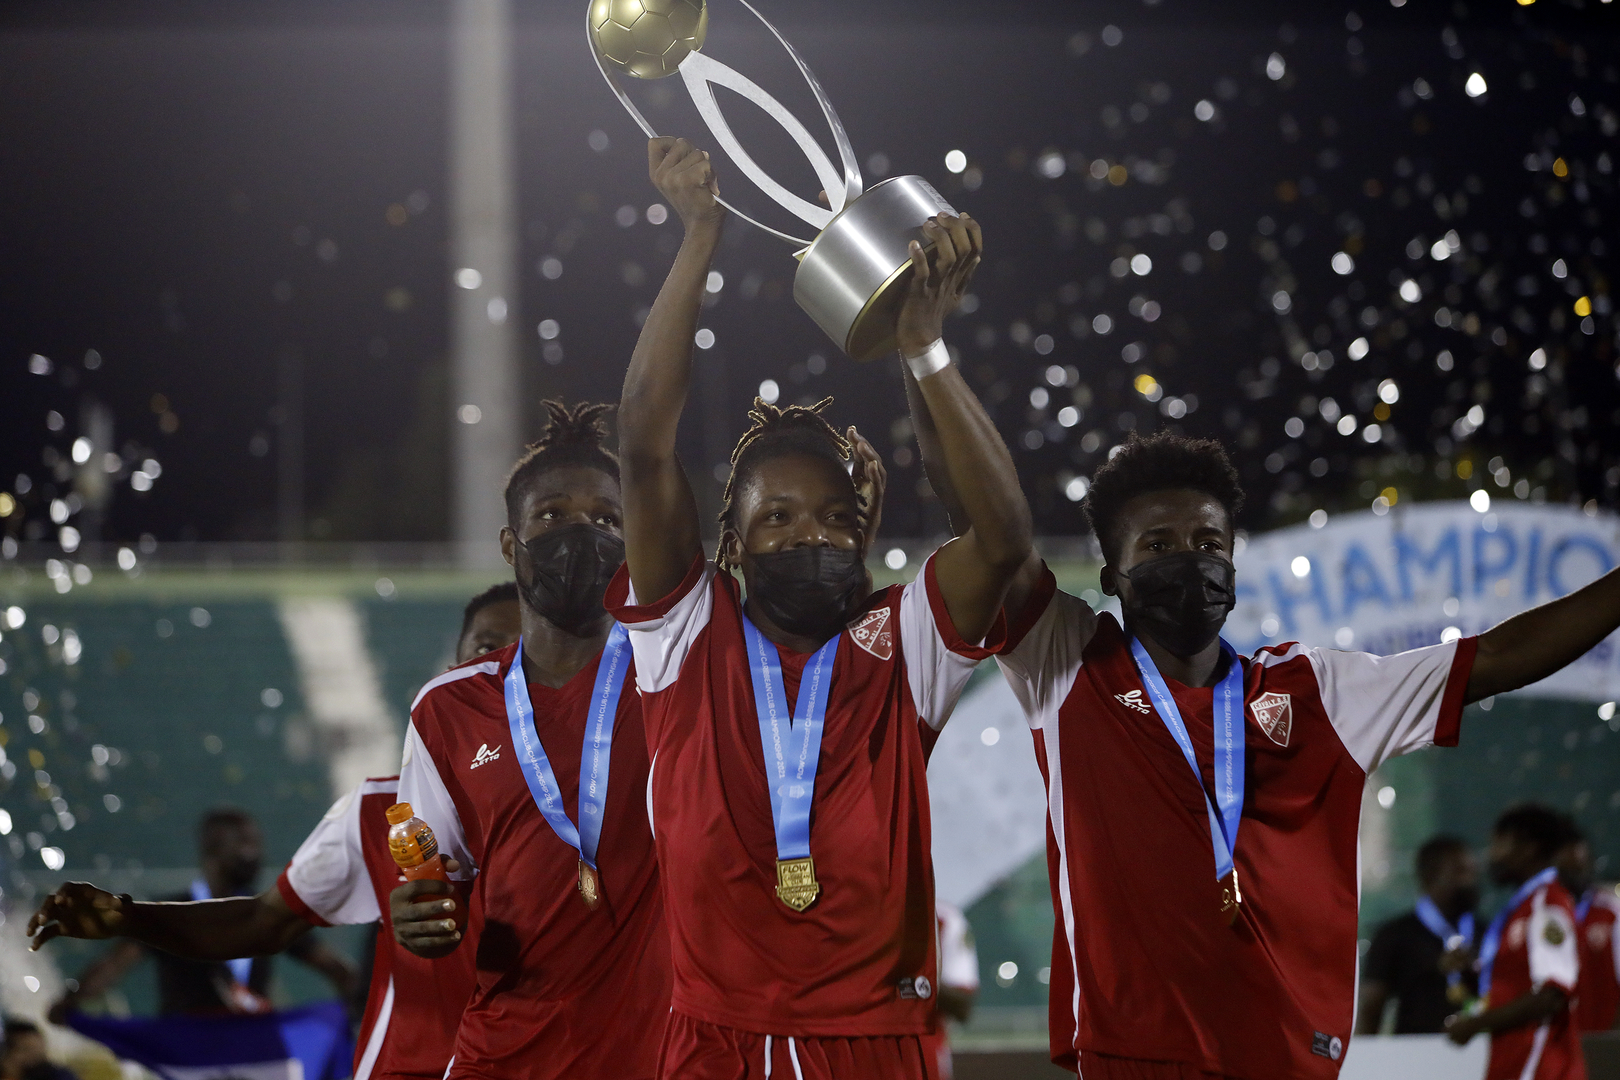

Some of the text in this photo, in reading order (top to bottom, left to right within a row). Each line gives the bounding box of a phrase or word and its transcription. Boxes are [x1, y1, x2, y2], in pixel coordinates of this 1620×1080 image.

[602, 656, 619, 699] CHAMPIONSHIP
[761, 656, 772, 692] CARIBBEAN
[811, 674, 820, 692] CLUB
[599, 698, 608, 714] CLUB
[766, 691, 775, 709] CLUB
[804, 691, 817, 728] CARIBBEAN
[594, 713, 605, 748] CARIBBEAN
[769, 708, 783, 761] CHAMPIONSHIP
[1225, 721, 1233, 738] CLUB
[800, 727, 811, 760] Concacaf
[522, 735, 532, 751] CLUB
[527, 750, 549, 793] CHAMPIONSHIP
[544, 792, 554, 808] 2021
[591, 748, 599, 779] Concacaf
[777, 761, 786, 779] 2021
[796, 760, 806, 780] FLOW
[589, 778, 597, 798] FLOW
[782, 863, 809, 873] FLOW
